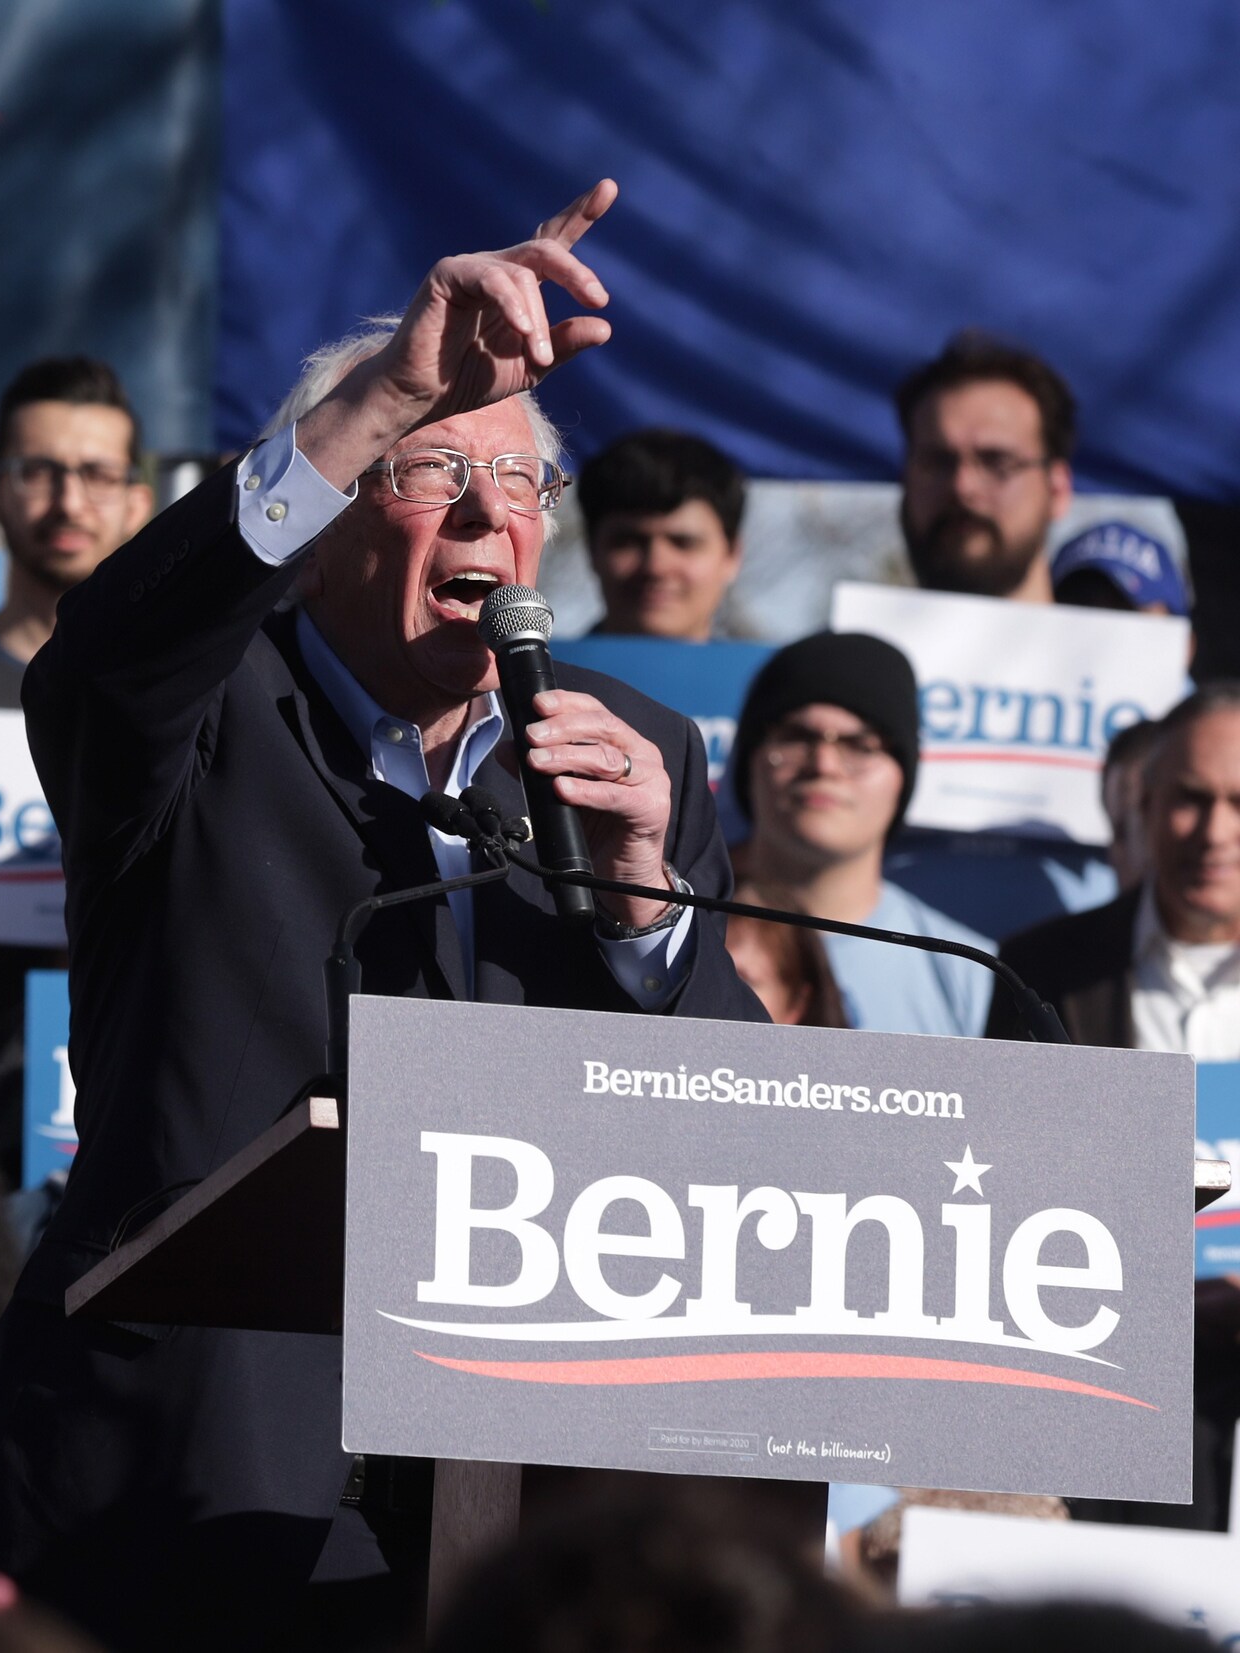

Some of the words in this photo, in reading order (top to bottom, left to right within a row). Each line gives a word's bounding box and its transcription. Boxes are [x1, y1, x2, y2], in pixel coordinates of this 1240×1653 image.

[583, 1061, 965, 1119] BernieSanders.com
[417, 1132, 1123, 1352] Bernie
[660, 1433, 678, 1445] Paid
[703, 1436, 728, 1447] Bernie
[730, 1438, 750, 1449] 2020
[767, 1436, 792, 1457] (not
[796, 1440, 816, 1456] the
[821, 1441, 891, 1463] billionaires)
